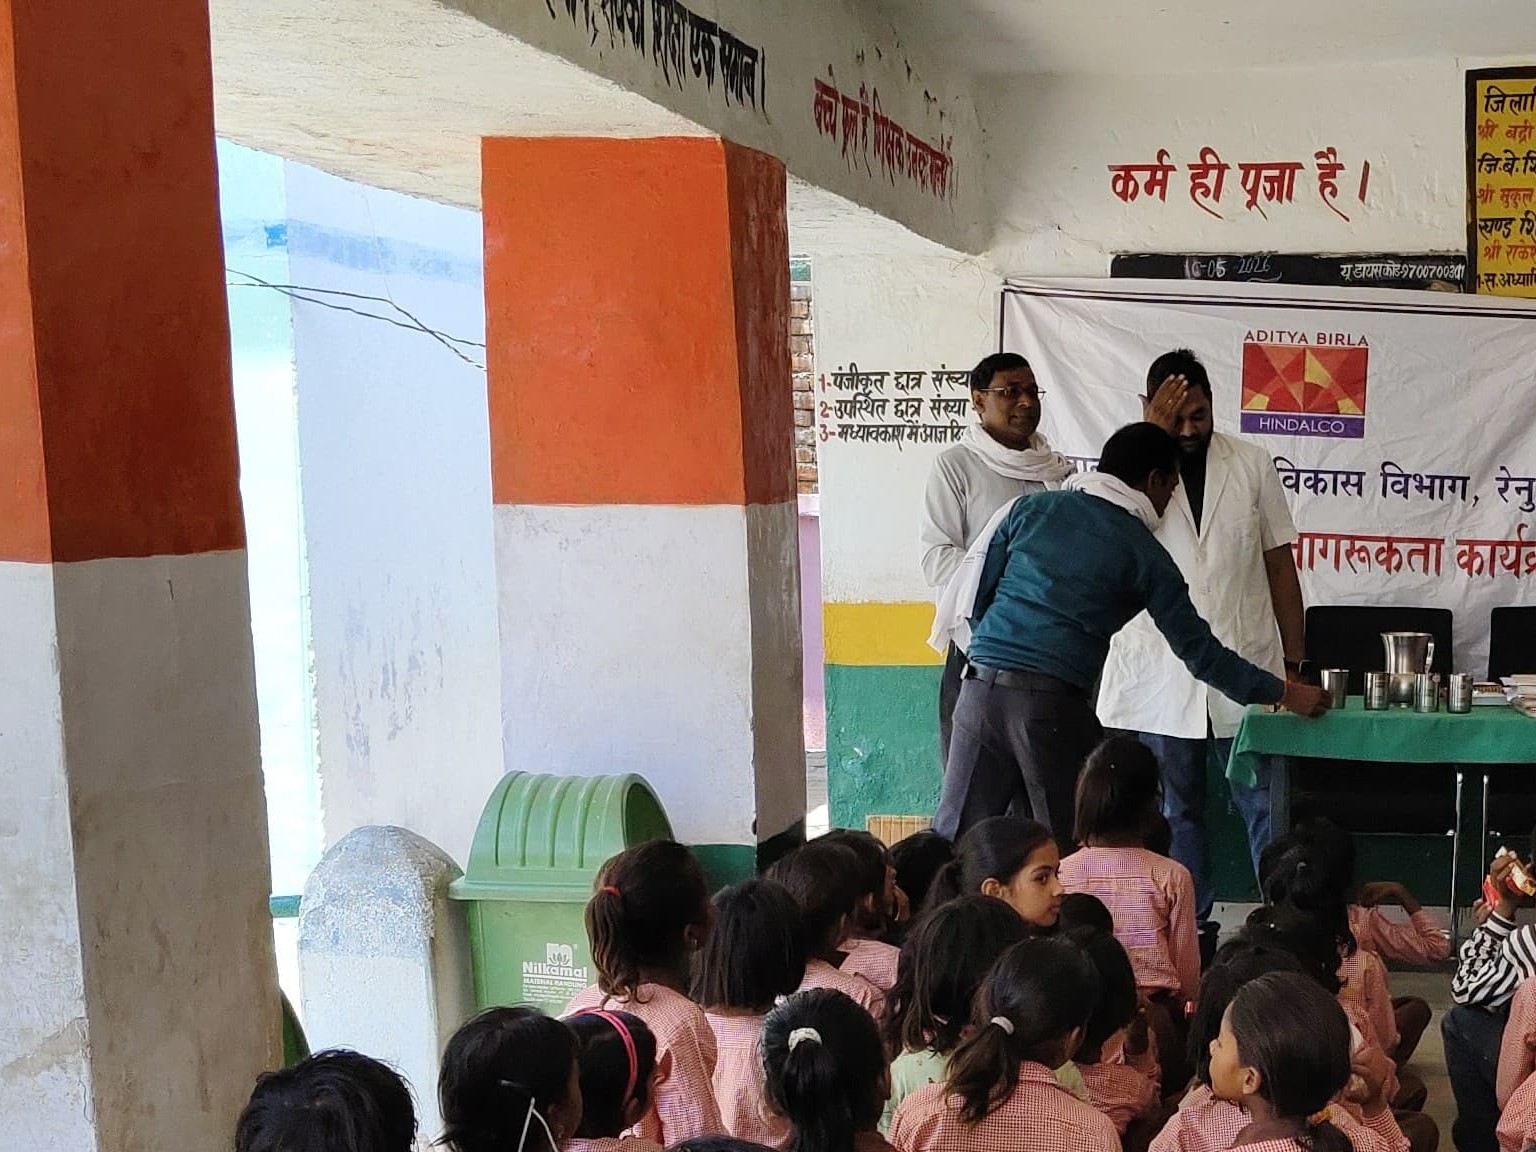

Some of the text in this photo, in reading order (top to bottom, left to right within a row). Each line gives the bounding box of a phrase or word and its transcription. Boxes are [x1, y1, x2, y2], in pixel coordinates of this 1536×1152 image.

[1478, 118, 1499, 141] श्री
[1107, 148, 1177, 204] कर्म
[1186, 146, 1231, 220] ही
[1237, 161, 1305, 221] पूजा
[1478, 216, 1516, 240] खण्ड
[1243, 330, 1369, 347] ADITYA BIRLA
[931, 363, 971, 392] संख्य
[1259, 417, 1345, 433] HINDALCO
[1273, 455, 1366, 497] विकास
[522, 961, 588, 978] Nilkamal
